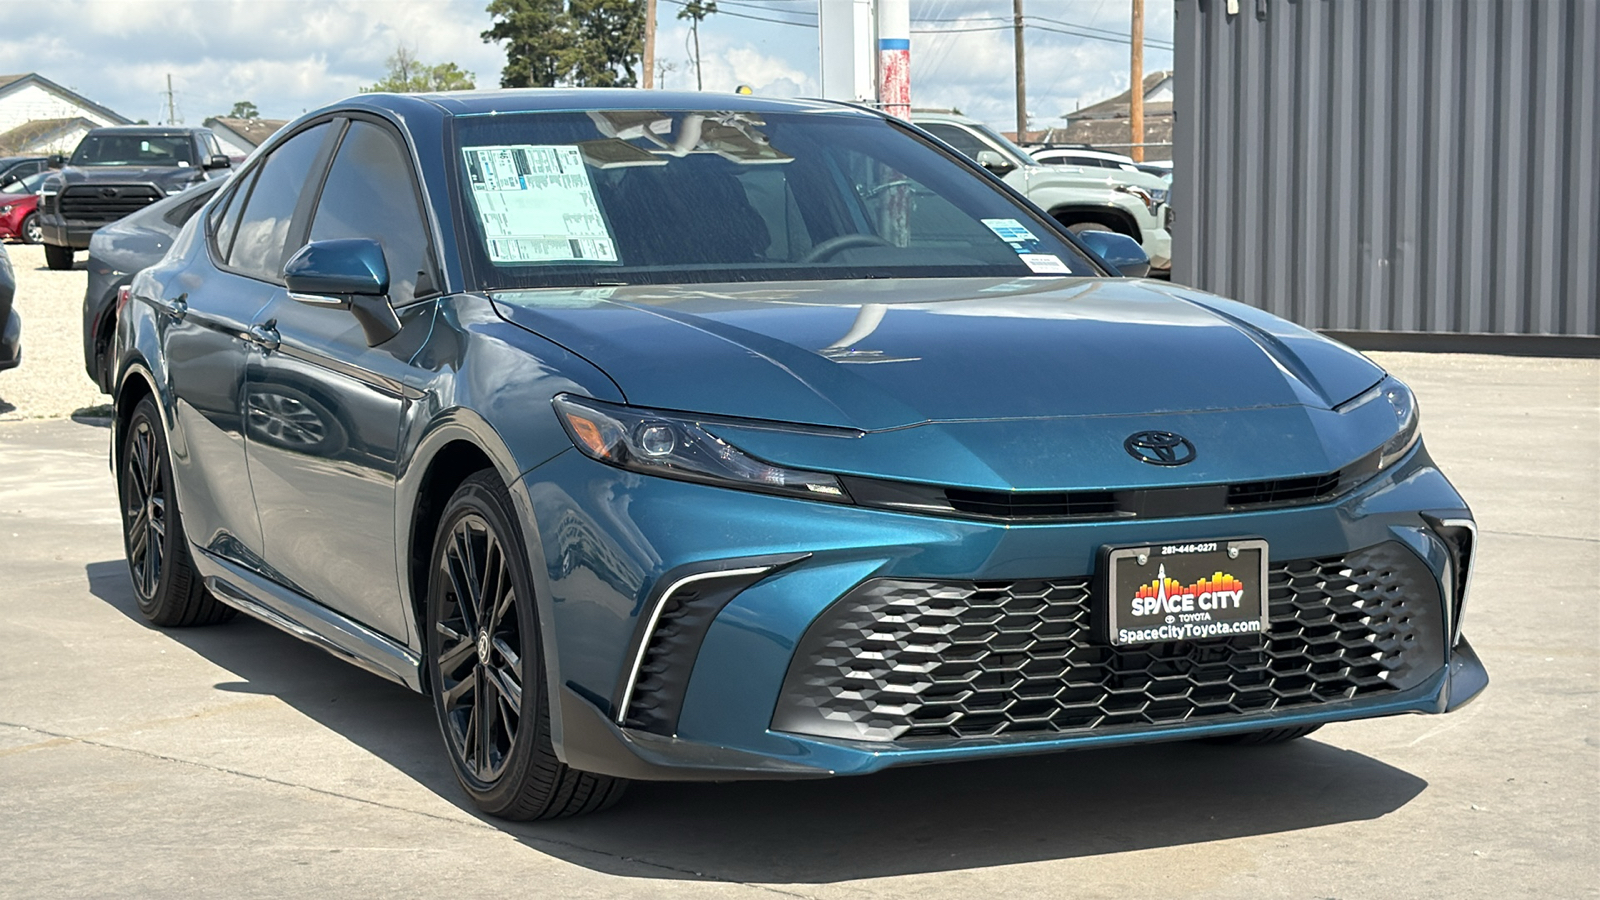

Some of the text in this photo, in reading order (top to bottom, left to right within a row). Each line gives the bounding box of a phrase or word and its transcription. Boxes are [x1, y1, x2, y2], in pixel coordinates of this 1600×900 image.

[1161, 543, 1217, 555] 281-446-0271
[1131, 590, 1244, 617] SPACE CITY
[1178, 612, 1211, 622] TOYOTA
[1119, 620, 1260, 643] SpaceCityToyota.com
